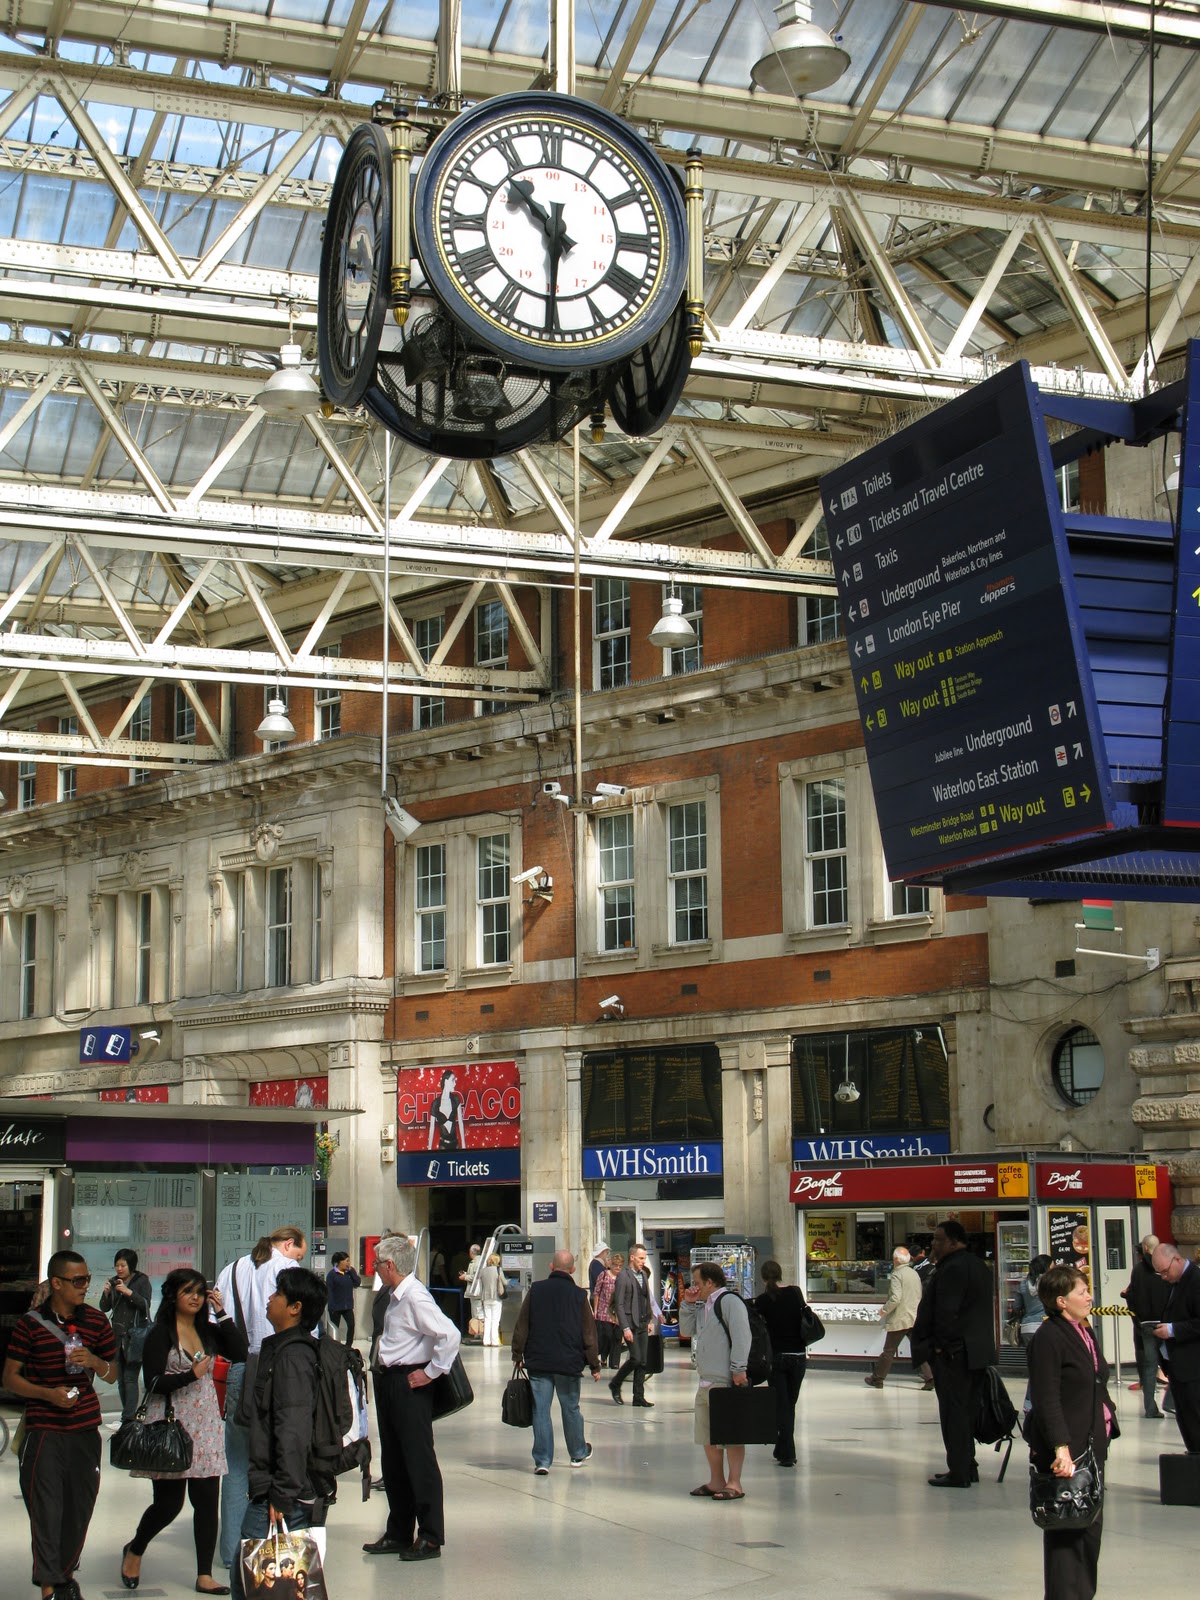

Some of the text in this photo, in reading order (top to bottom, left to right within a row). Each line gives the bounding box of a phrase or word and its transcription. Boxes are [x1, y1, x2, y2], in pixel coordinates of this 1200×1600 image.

[546, 171, 560, 180] 00
[574, 183, 587, 192] 13
[593, 206, 606, 216] 14
[492, 220, 505, 230] 21
[600, 234, 614, 244] 15
[498, 246, 514, 256] 20
[520, 269, 532, 279] 19
[592, 260, 606, 271] 16
[574, 278, 588, 288] 17
[862, 472, 892, 497] Toilets
[869, 464, 984, 533] Tickets and Travel Centre
[875, 548, 898, 570] Taxis
[942, 529, 1006, 568] Bakerloo, Northern and
[944, 549, 1004, 583] Waterloo & City lines
[880, 565, 941, 607] Underground
[980, 582, 1016, 604] clippers
[986, 575, 1015, 592] thames
[887, 600, 961, 644] London Eye Pier
[894, 660, 916, 680] Way
[917, 650, 935, 672] out
[954, 642, 976, 656] Station
[976, 629, 1004, 648] Approach
[900, 698, 920, 718] Way
[922, 690, 940, 710] out
[966, 714, 1033, 752] Underground
[934, 746, 964, 764] Jubilee line
[932, 759, 1039, 802] Waterloo East Station
[999, 796, 1047, 824] Way out
[910, 821, 942, 837] Westminster
[942, 815, 960, 828] Bridge
[960, 809, 974, 822] Road
[938, 830, 962, 845] Waterloo
[962, 826, 978, 838] Road
[398, 1086, 521, 1124] CHAGO
[0, 1124, 45, 1146] hase
[447, 1160, 490, 1176] Tickets
[596, 1146, 709, 1177] WHSmith
[286, 1166, 320, 1180] Tiks
[1047, 1170, 1082, 1192] Bagel
[794, 1172, 842, 1200] Bagel
